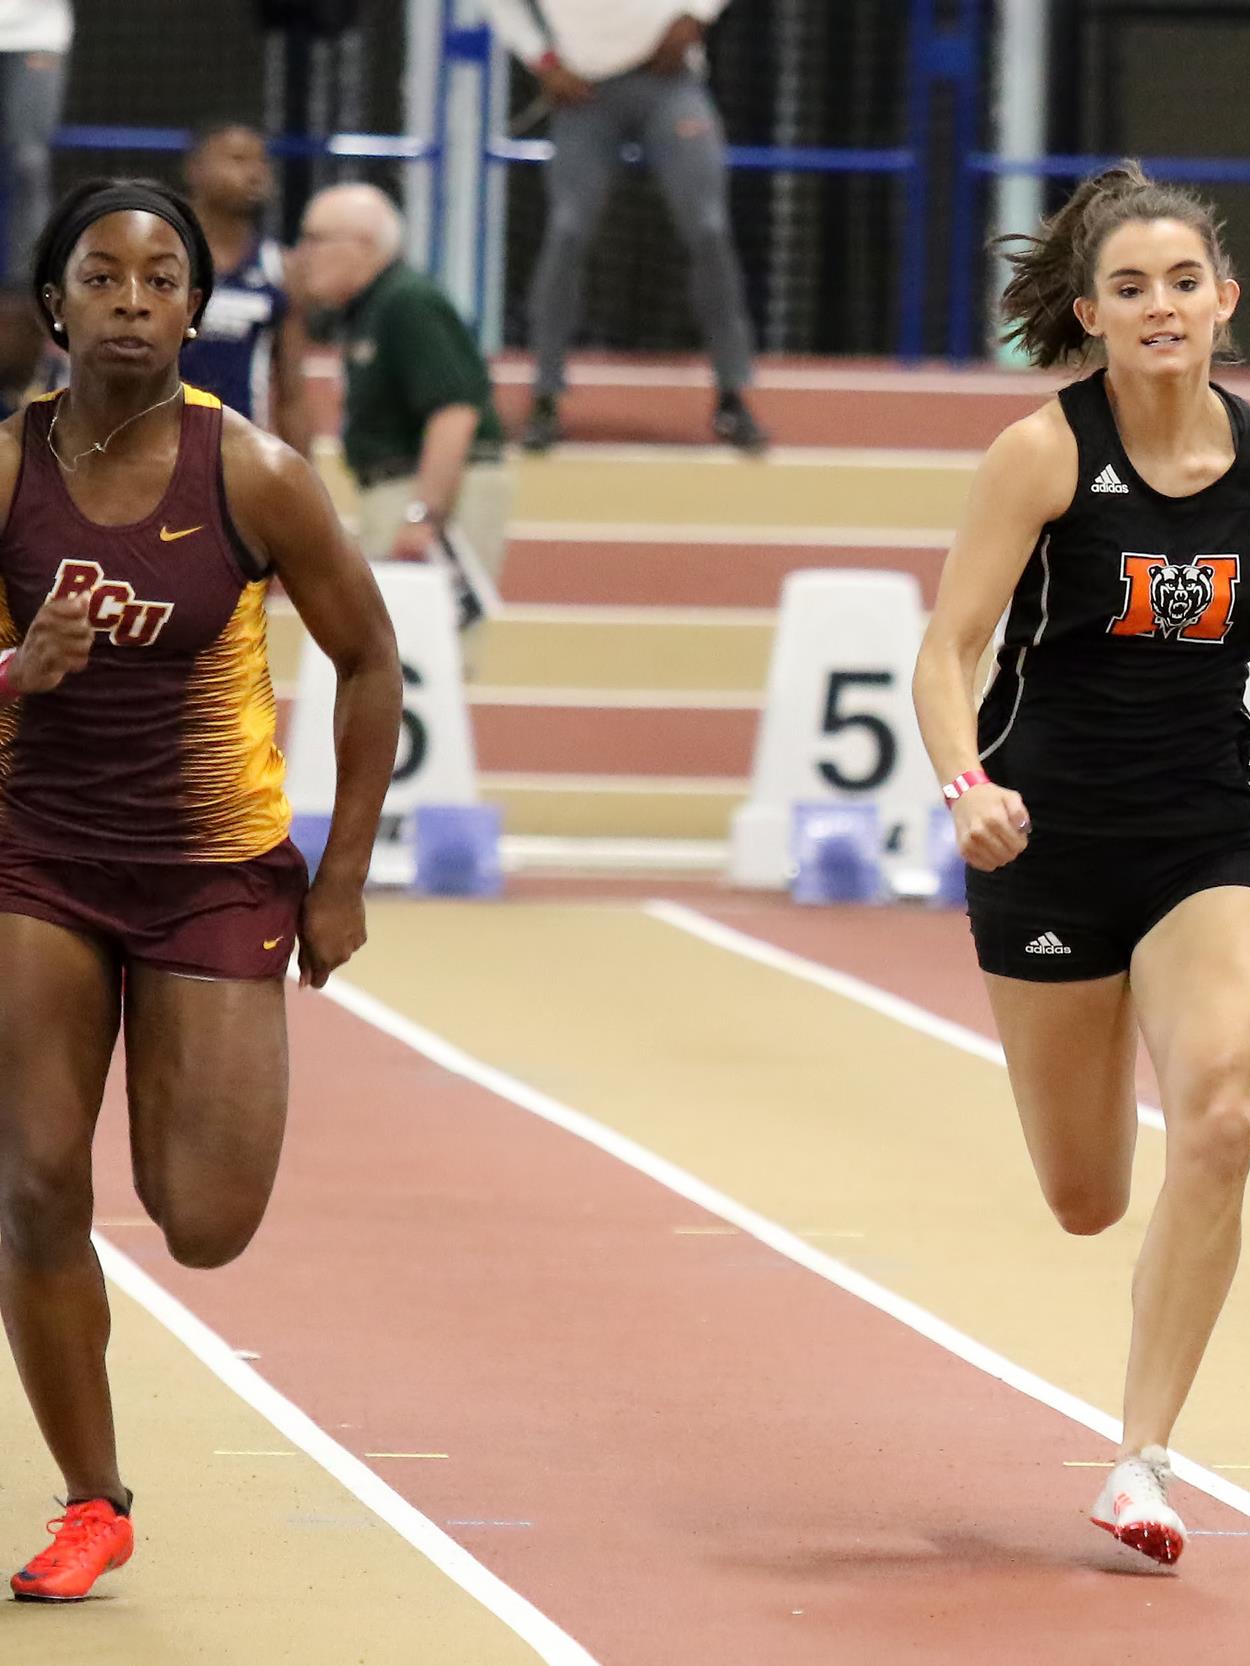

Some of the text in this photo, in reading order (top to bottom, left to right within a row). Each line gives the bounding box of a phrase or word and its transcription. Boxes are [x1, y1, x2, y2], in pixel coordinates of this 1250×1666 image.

[1090, 483, 1129, 494] adidas
[818, 671, 897, 792] 5
[1025, 945, 1072, 955] adidas
